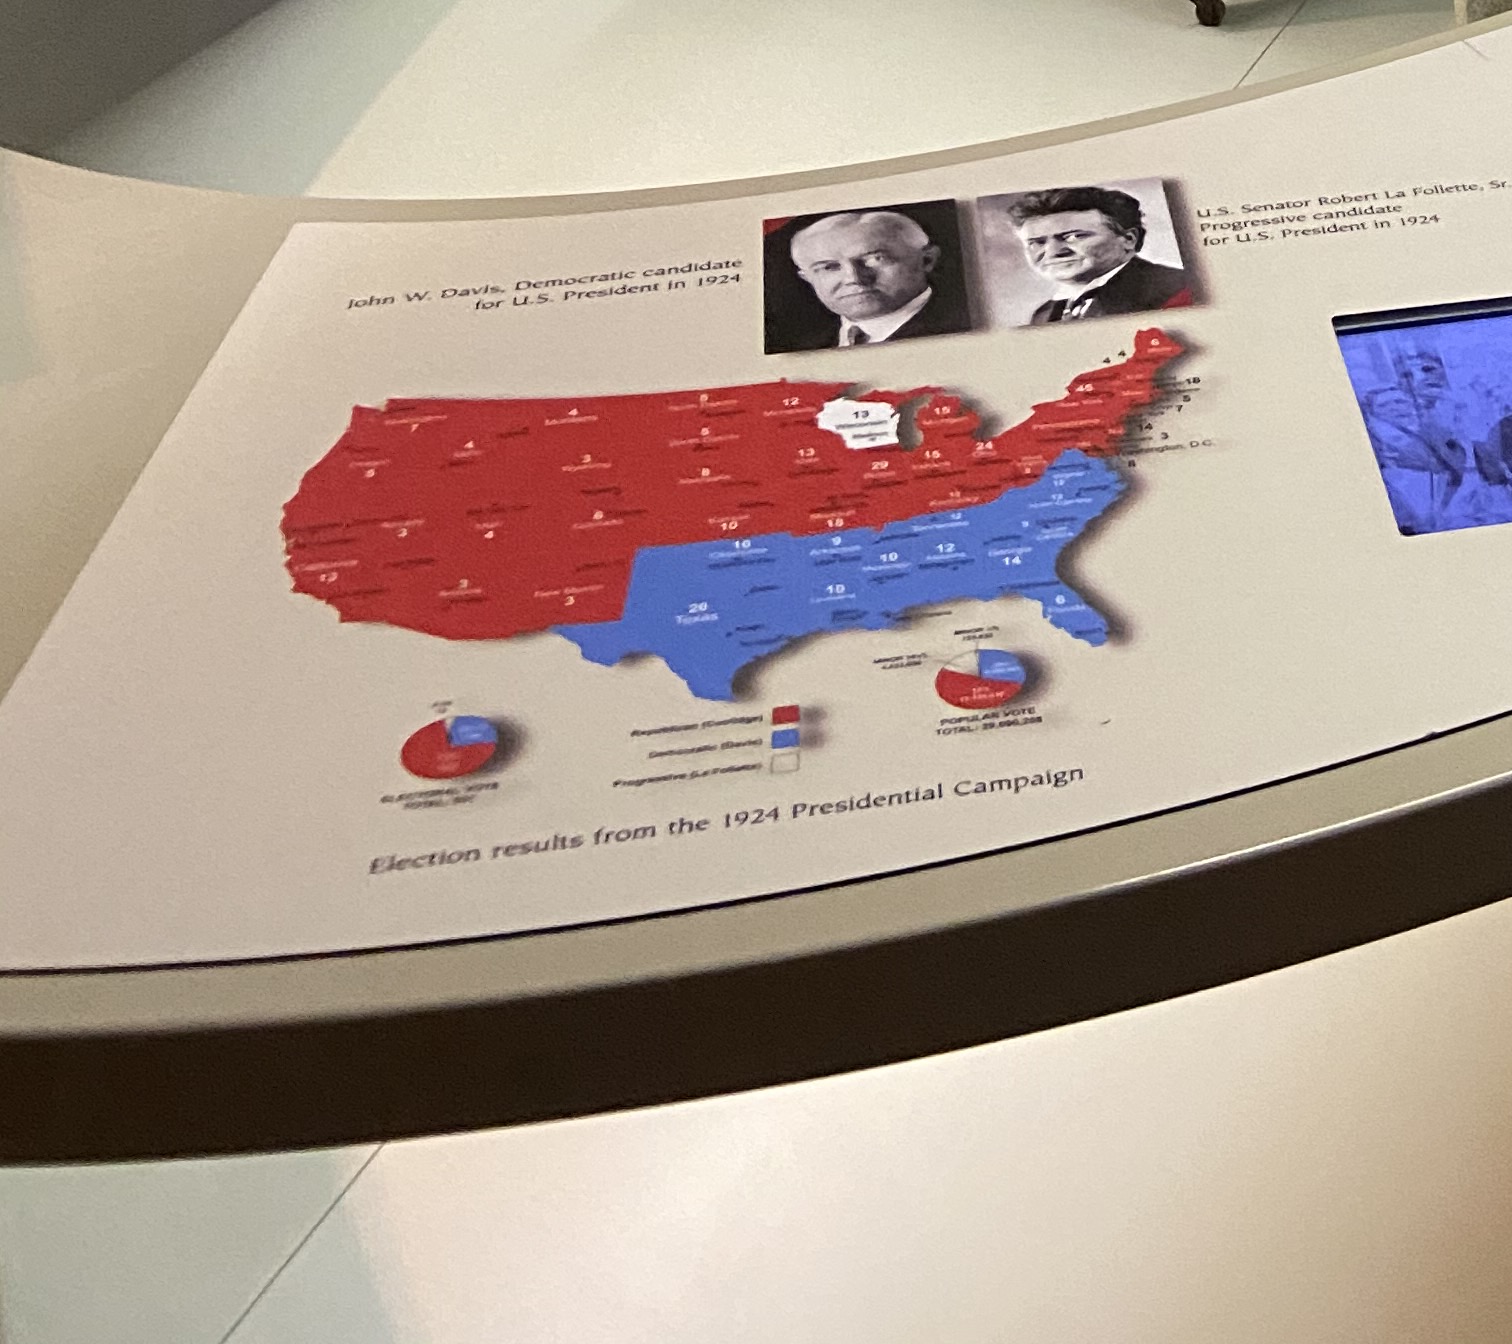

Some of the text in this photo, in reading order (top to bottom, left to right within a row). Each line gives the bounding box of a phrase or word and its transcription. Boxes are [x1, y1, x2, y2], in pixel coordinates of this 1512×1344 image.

[1197, 205, 1235, 218] U.S.
[1241, 198, 1311, 214] Senator
[1318, 191, 1378, 207] Robert
[1385, 189, 1406, 200] La
[1200, 203, 1404, 233] Progressive candidate
[1202, 214, 1440, 247] for U.S. President in 1924
[347, 258, 743, 310] John W. Davis, Democratic candidate
[475, 272, 741, 311] for U.S. President in 1924
[1003, 556, 1022, 565] 14
[369, 767, 1084, 875] Election results from the 1924 Presidential Campaign
